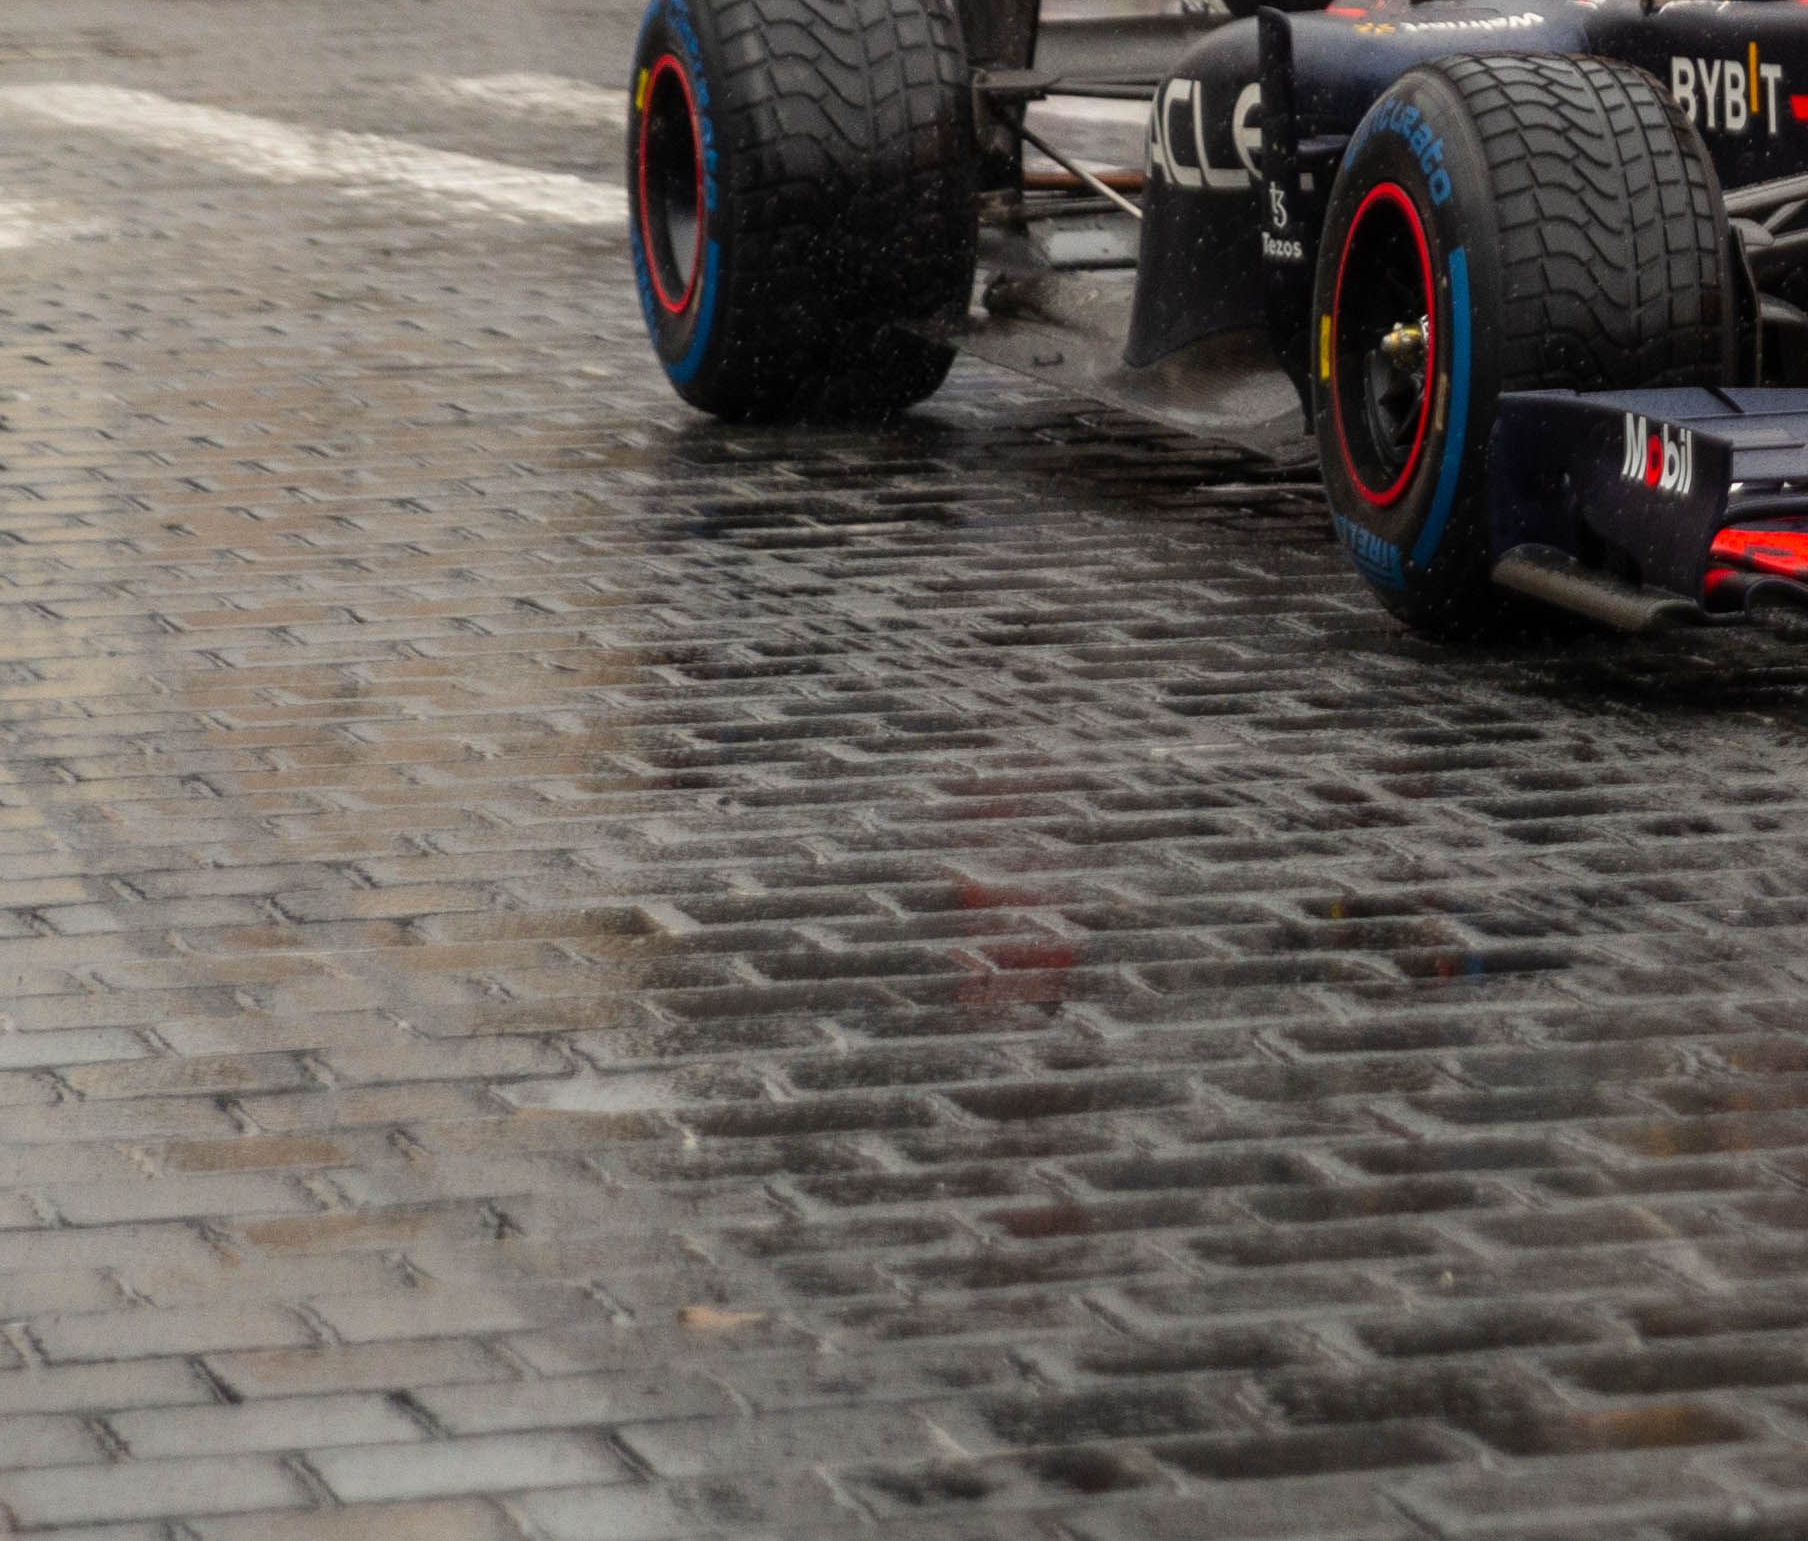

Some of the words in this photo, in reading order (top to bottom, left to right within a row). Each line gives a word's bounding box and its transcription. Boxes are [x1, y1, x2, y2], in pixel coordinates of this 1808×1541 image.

[1671, 41, 1782, 135] BYBIT
[1261, 231, 1303, 259] Tezos
[1621, 411, 1693, 495] Mobil
